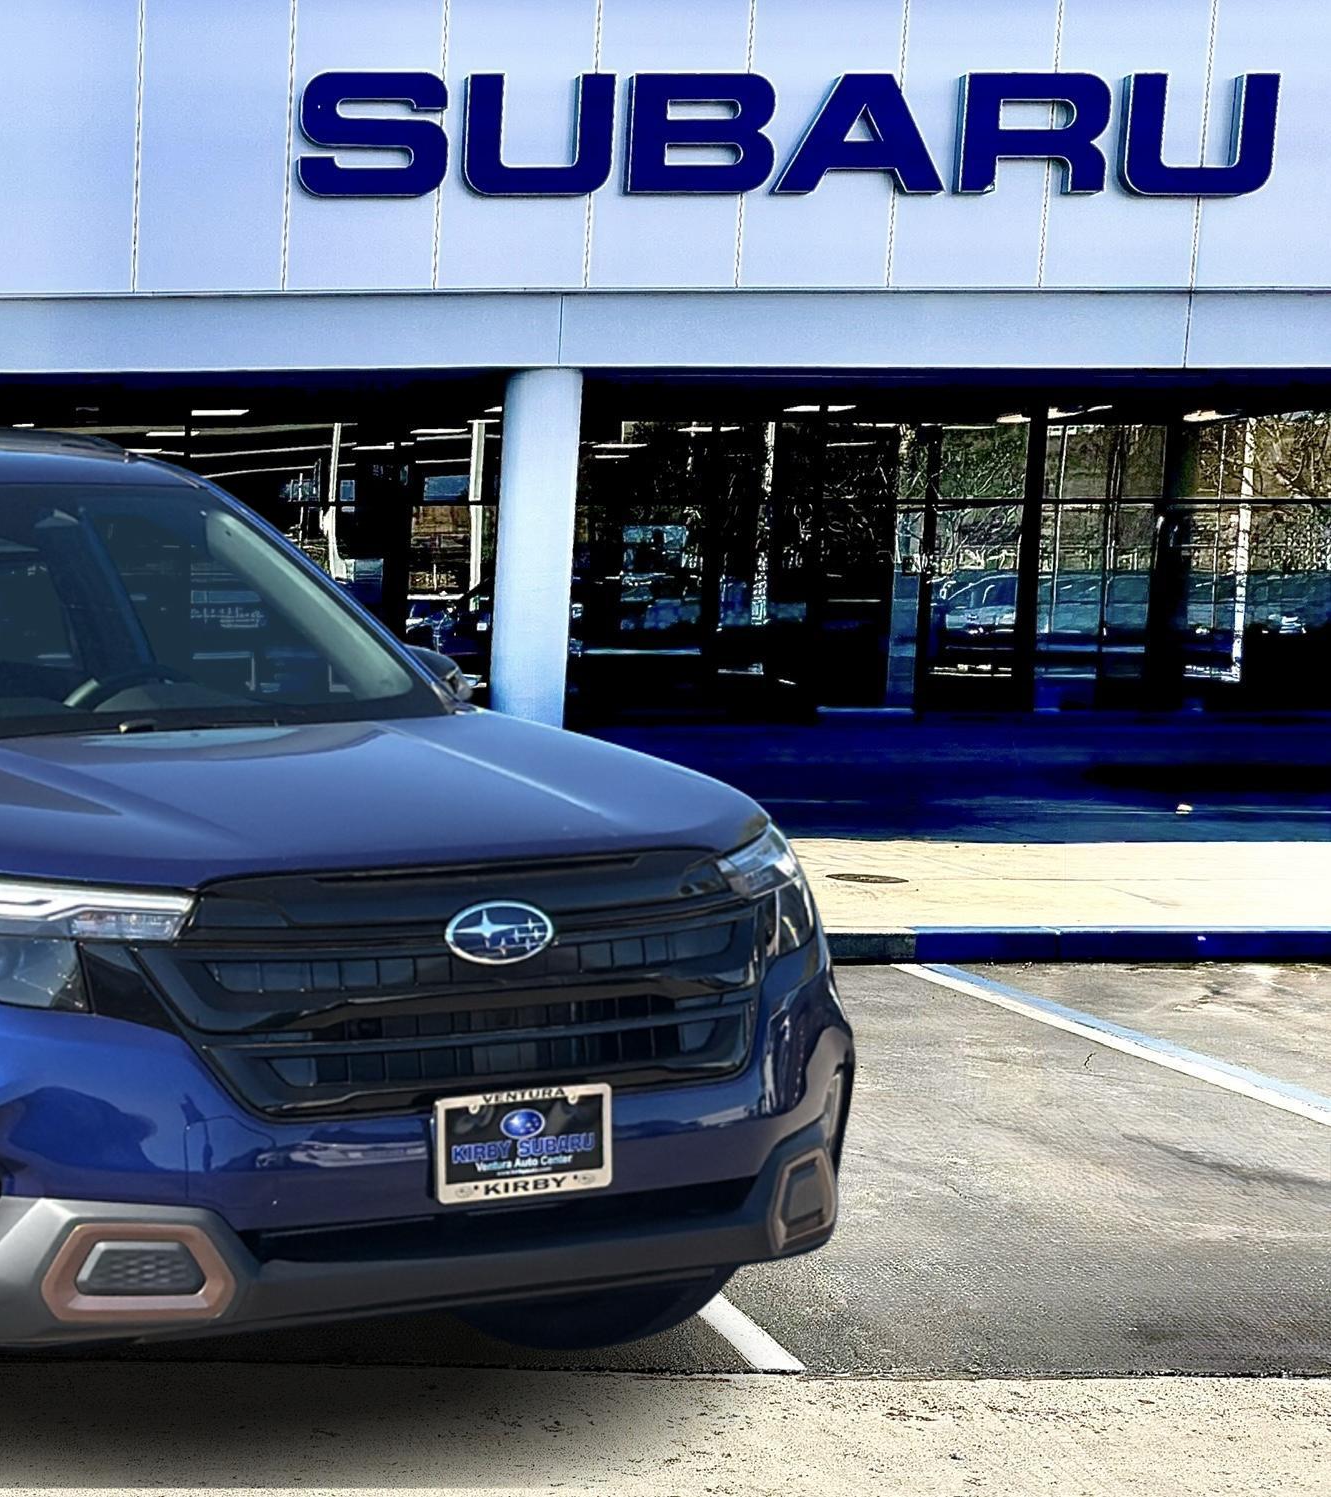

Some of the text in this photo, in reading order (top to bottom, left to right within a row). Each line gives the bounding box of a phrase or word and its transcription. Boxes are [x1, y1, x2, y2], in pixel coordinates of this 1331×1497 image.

[297, 70, 1282, 198] SUBARU
[483, 1088, 565, 1103] VENTURA
[453, 1132, 595, 1163] KIRBY SUBARU
[475, 1161, 512, 1172] Ventura
[514, 1157, 538, 1168] Auto
[540, 1155, 573, 1165] Center
[484, 1176, 566, 1195] KIRBY
